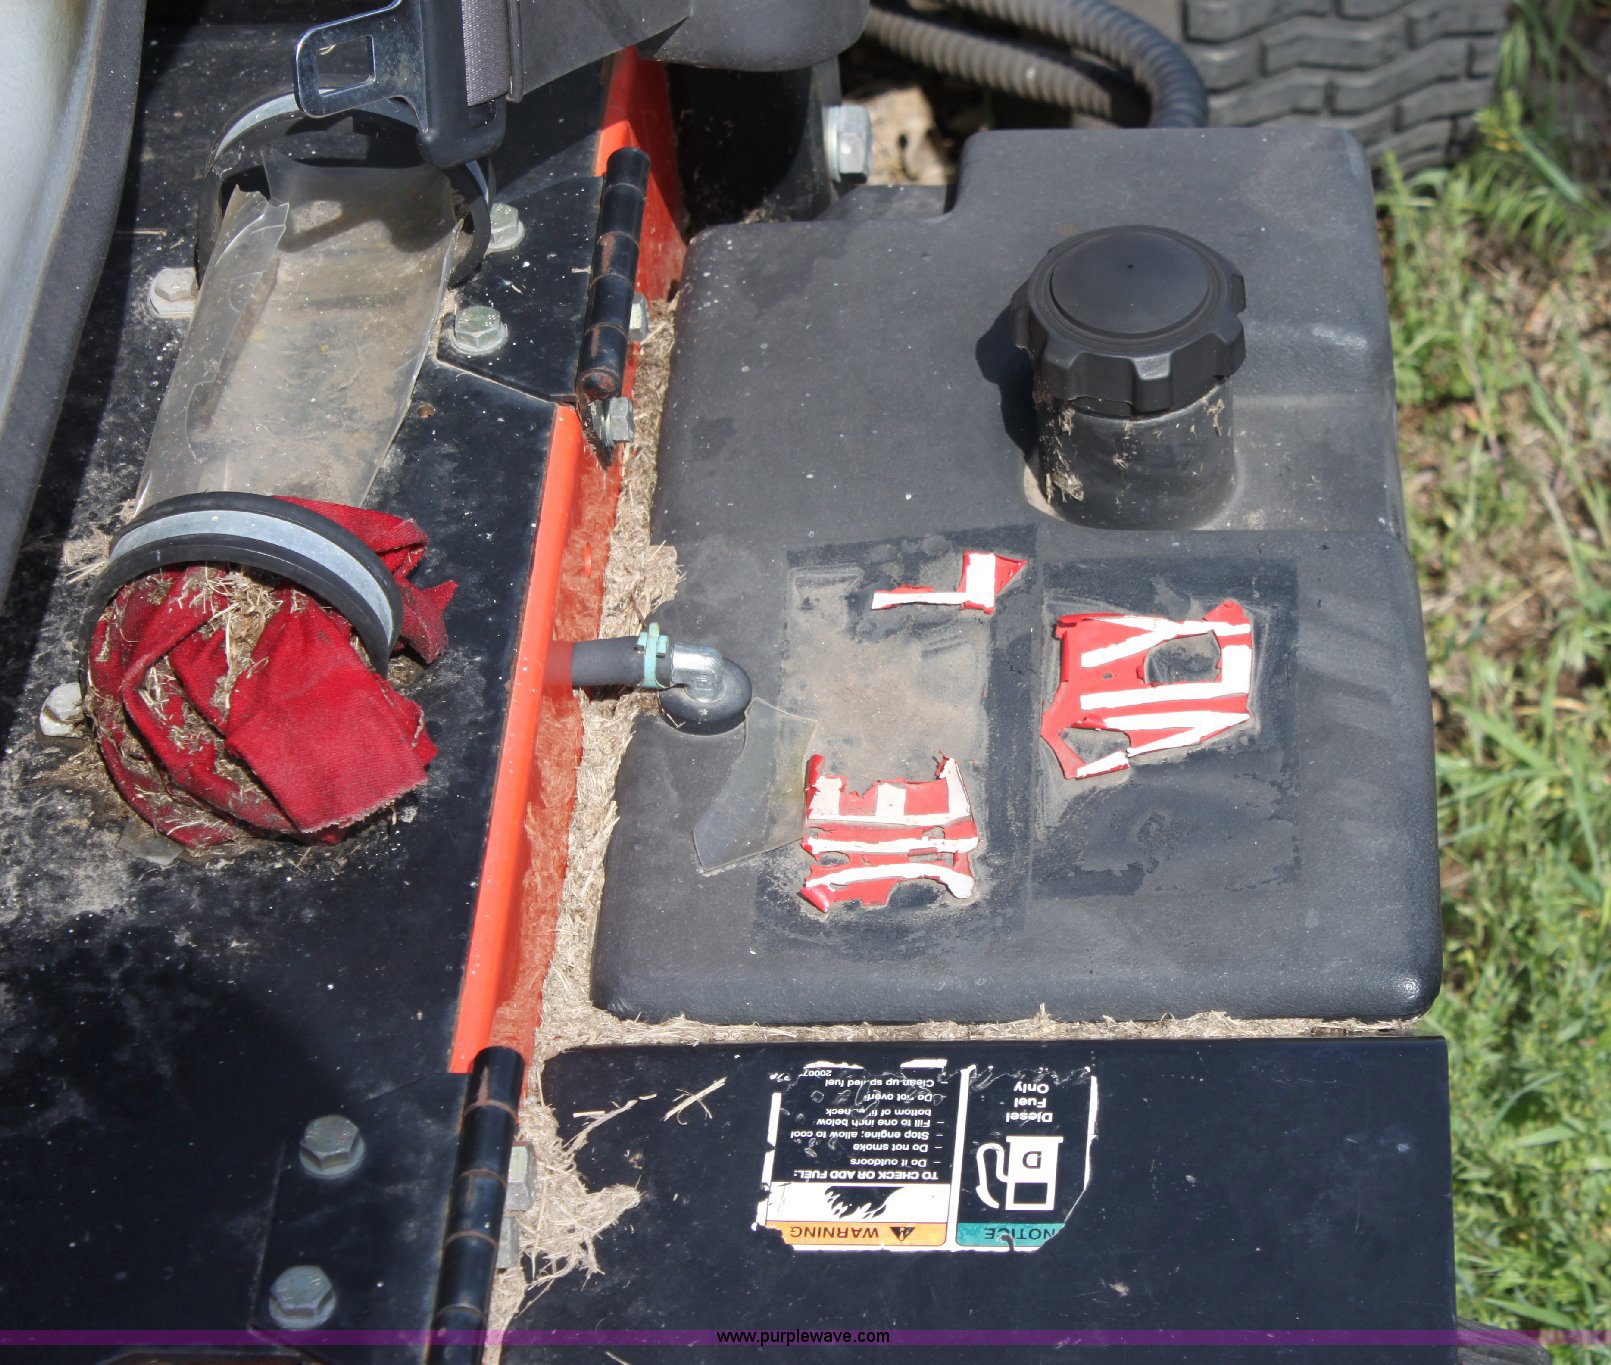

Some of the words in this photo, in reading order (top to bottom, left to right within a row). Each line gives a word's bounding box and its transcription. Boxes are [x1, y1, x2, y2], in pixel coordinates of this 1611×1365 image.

[798, 1069, 832, 1077] 20007
[886, 1077, 900, 1085] up
[902, 1079, 934, 1087] Clean
[1013, 1081, 1050, 1094] Only
[917, 1094, 932, 1102] Do
[1014, 1097, 1047, 1108] Fuel
[825, 1108, 850, 1116] neck
[880, 1108, 891, 1116] of
[1006, 1112, 1053, 1122] Diesel
[816, 1118, 848, 1127] below
[851, 1119, 875, 1127] inch
[914, 1119, 930, 1127] Fill
[790, 1131, 813, 1139] cool
[830, 1131, 858, 1139] allow
[861, 1130, 900, 1139] engine;
[904, 1130, 929, 1140] Stop
[852, 1144, 889, 1152] smoke
[892, 1144, 909, 1152] not
[912, 1144, 928, 1152] Do
[850, 1158, 898, 1167] outdoors
[901, 1158, 908, 1167] it
[911, 1158, 927, 1167] Do
[1022, 1150, 1042, 1168] D
[793, 1170, 828, 1179] FUEL:
[830, 1170, 856, 1179] ADD
[858, 1170, 875, 1179] OR
[878, 1171, 919, 1179] CHECK
[921, 1171, 938, 1180] TO
[790, 1226, 879, 1238] WARNING
